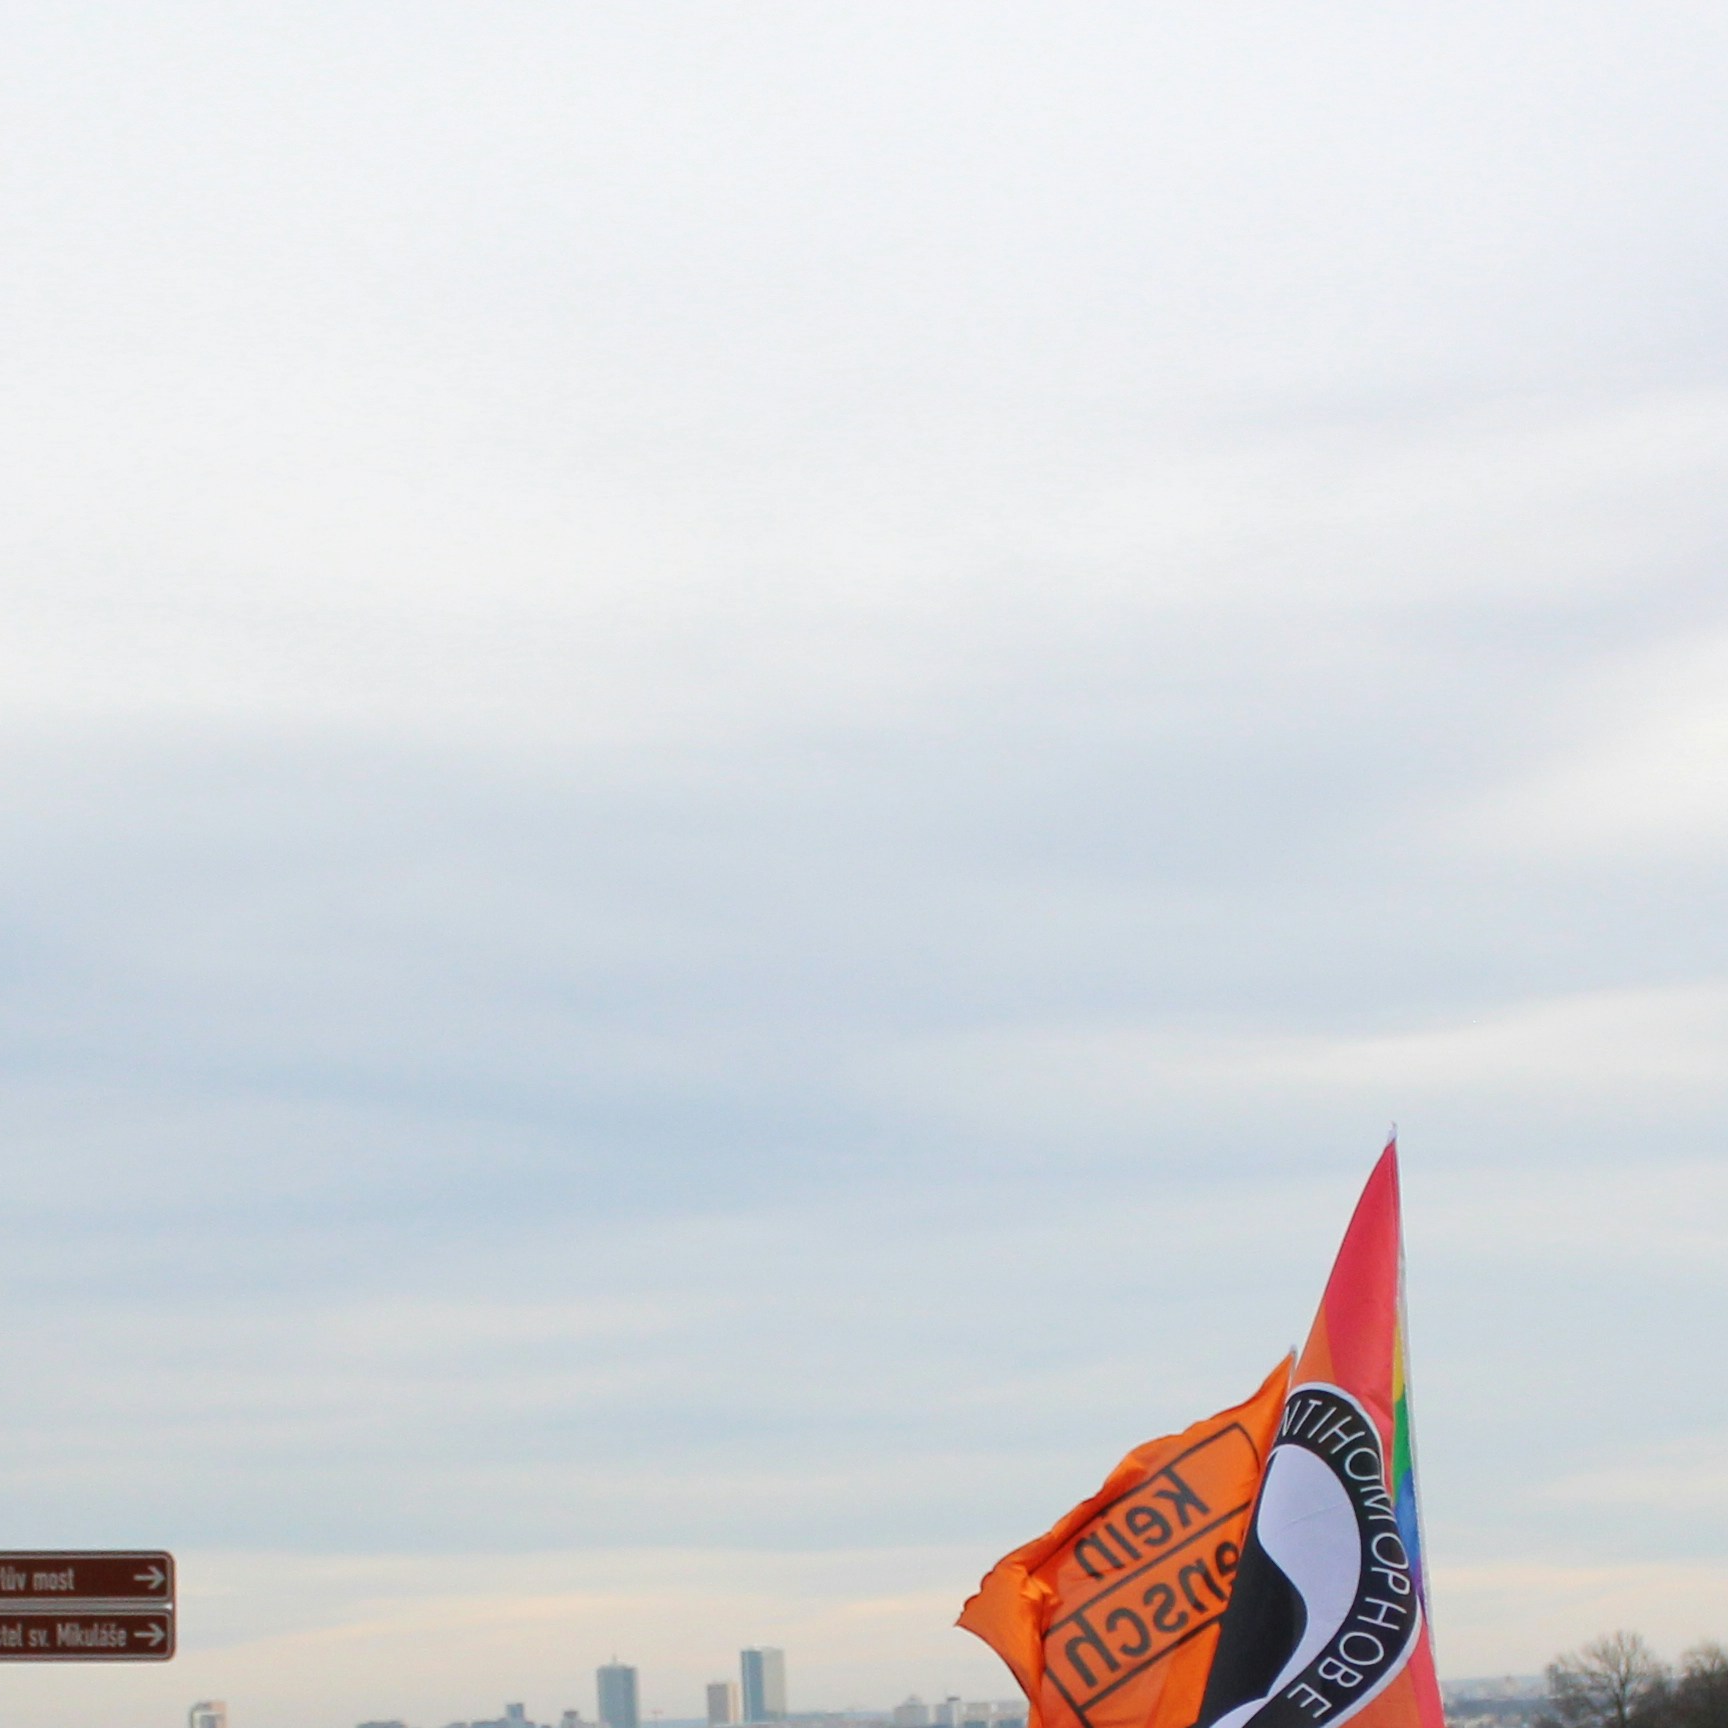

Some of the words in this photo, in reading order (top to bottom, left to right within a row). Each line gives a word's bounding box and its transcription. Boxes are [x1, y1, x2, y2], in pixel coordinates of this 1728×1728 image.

[1281, 1399, 1411, 1720] NTIHOMOPHOBE
[32, 1567, 75, 1590] most
[29, 1629, 49, 1647] sv.
[55, 1621, 127, 1647] Mikuláše
